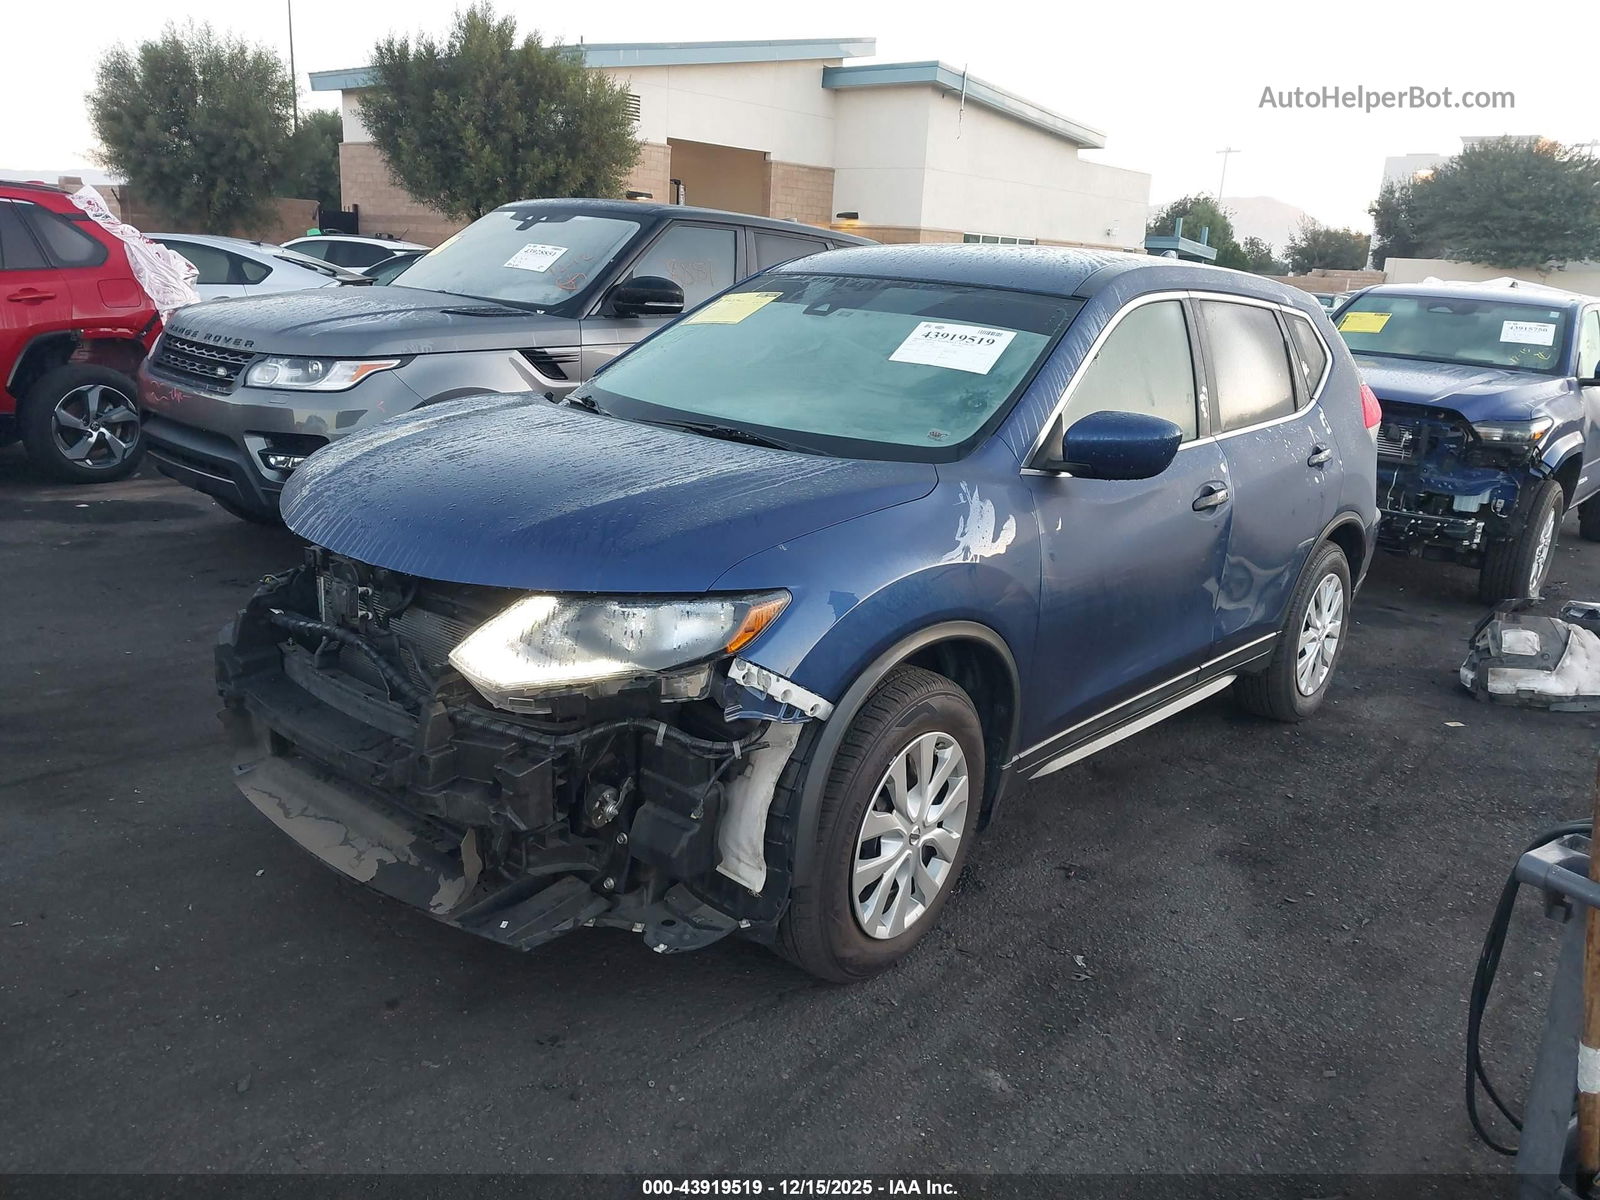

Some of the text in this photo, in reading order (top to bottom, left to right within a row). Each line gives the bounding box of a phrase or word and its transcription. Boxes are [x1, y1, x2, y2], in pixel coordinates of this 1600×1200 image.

[168, 323, 255, 349] RANGE ROVER
[922, 330, 996, 347] 43919519
